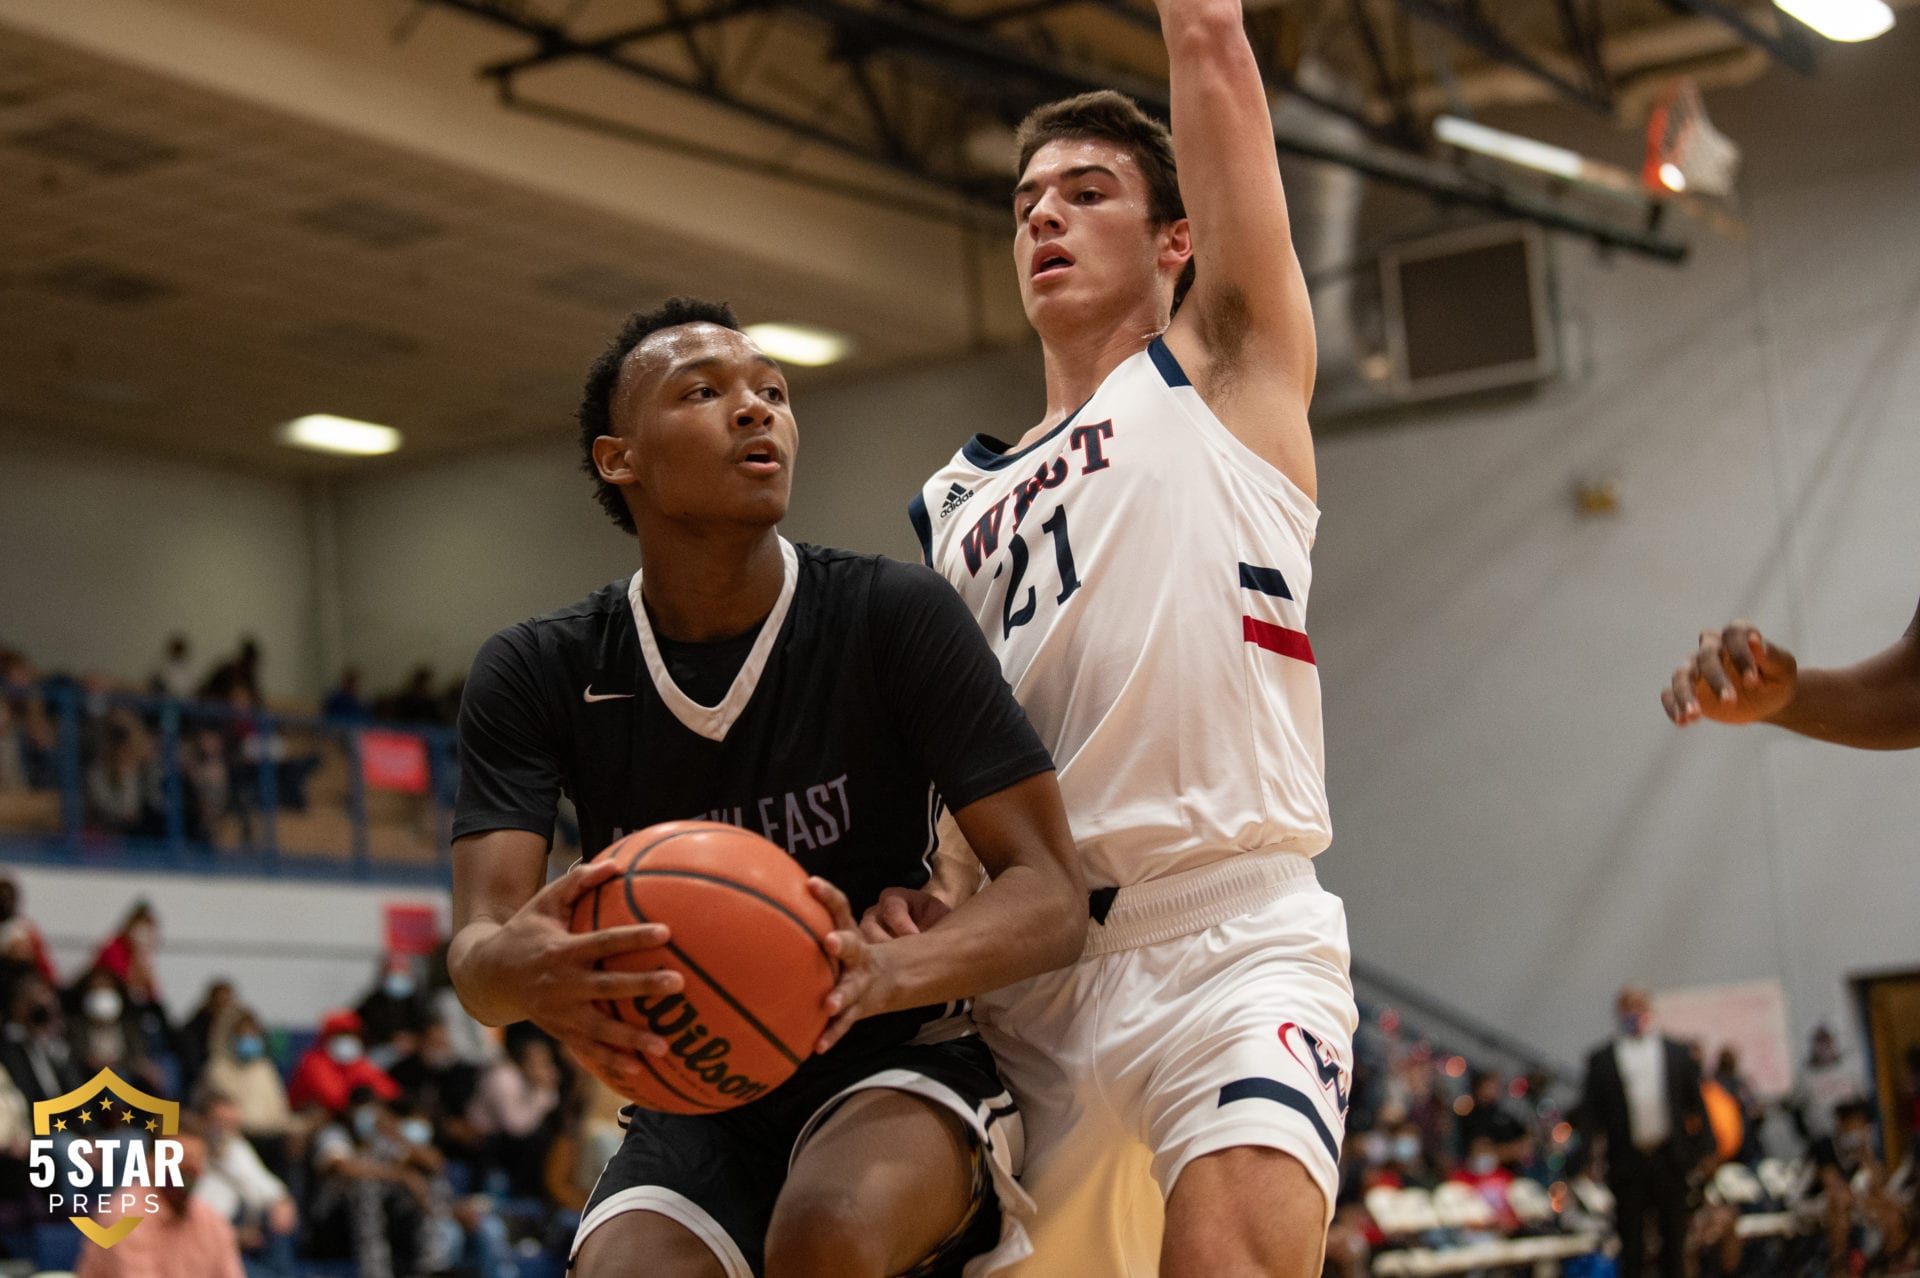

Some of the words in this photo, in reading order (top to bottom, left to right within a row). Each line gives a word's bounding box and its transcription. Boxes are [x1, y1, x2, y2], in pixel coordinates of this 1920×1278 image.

[940, 489, 974, 518] adidas
[993, 503, 1082, 641] 21
[633, 965, 769, 1100] Wilson
